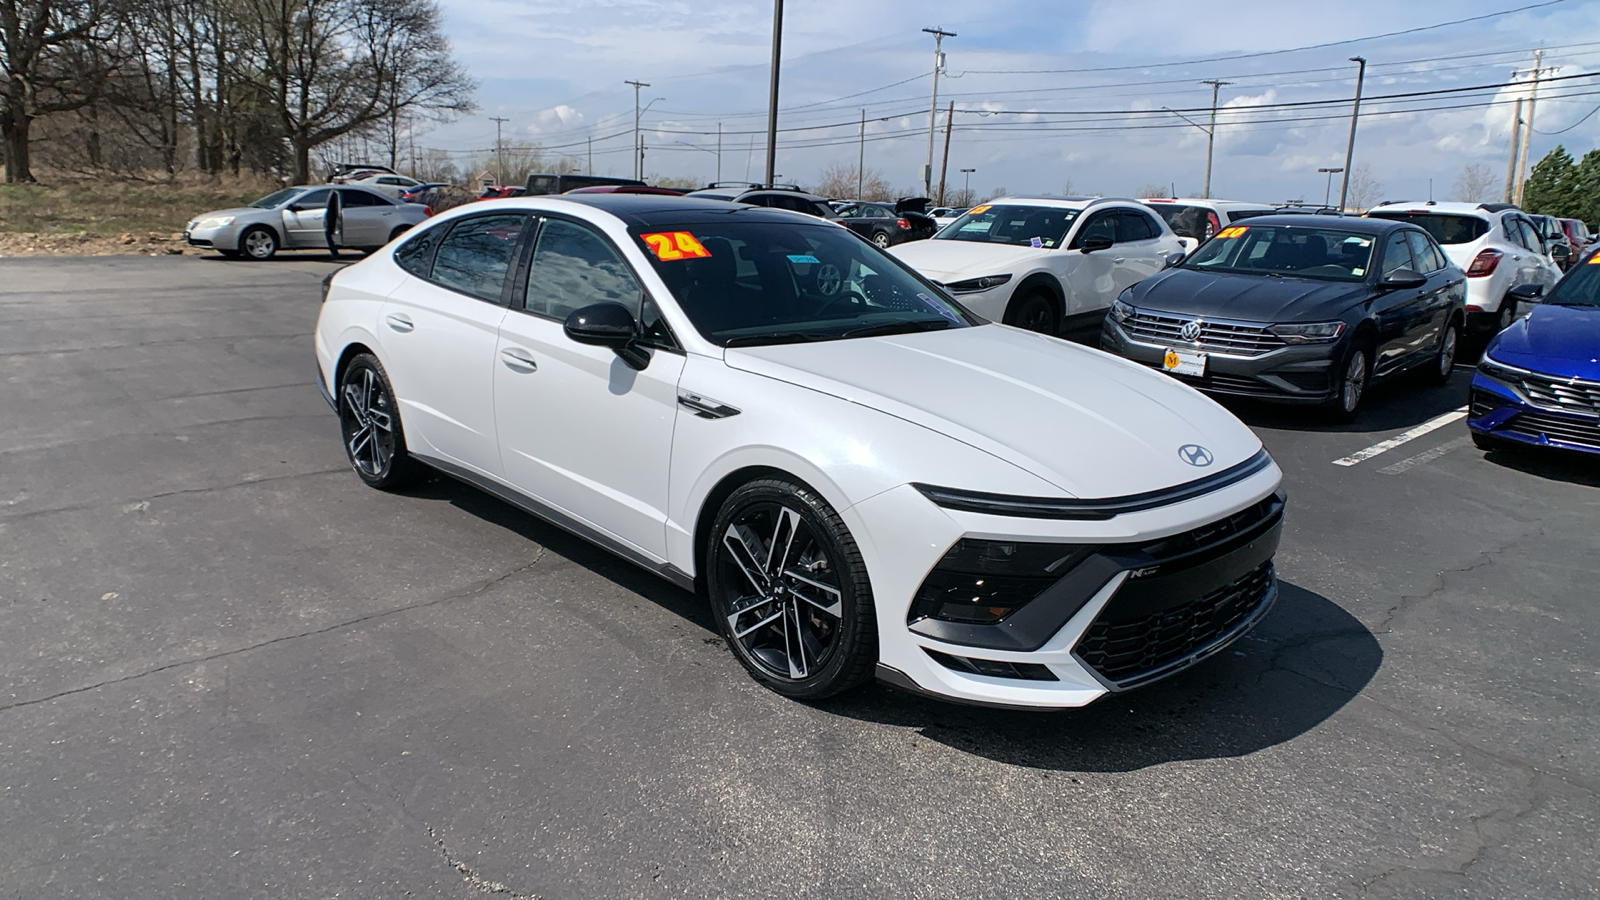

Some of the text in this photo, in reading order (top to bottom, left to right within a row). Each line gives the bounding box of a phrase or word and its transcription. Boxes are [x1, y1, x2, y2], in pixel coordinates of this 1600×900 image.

[1215, 226, 1248, 239] 20
[645, 232, 707, 260] 24
[1168, 356, 1178, 366] M
[774, 586, 784, 594] N
